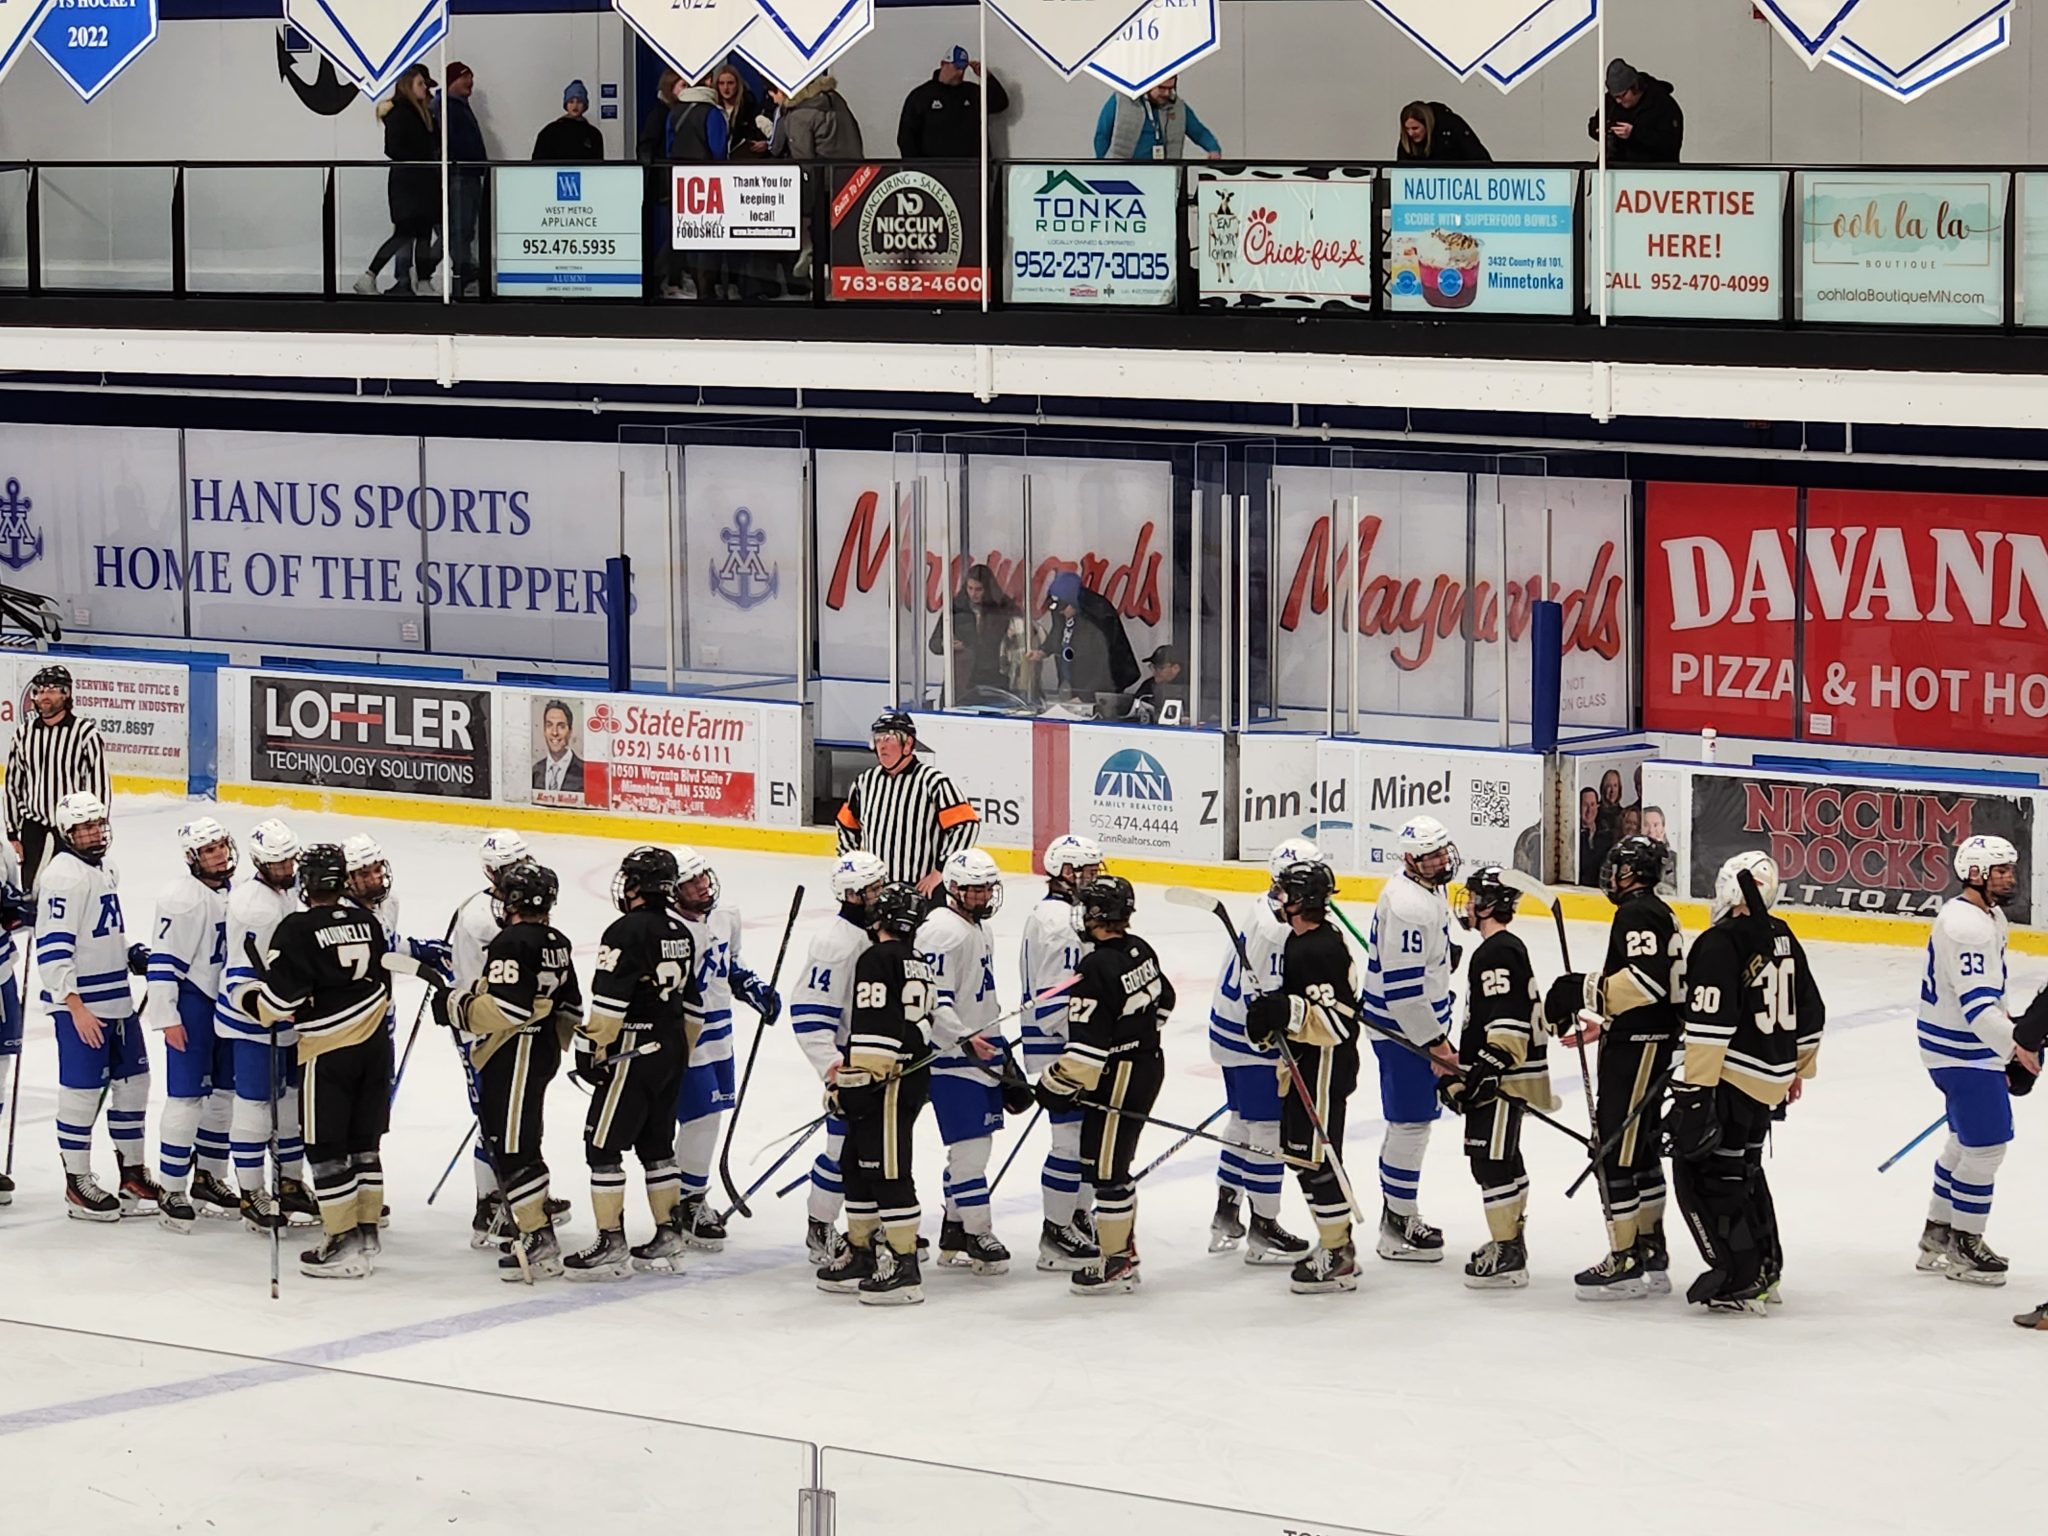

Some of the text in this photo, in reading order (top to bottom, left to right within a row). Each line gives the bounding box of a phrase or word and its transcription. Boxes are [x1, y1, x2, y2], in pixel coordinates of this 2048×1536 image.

[67, 26, 108, 47] 2022
[1115, 17, 1160, 41] 016
[733, 176, 793, 188] Thank You for
[1404, 178, 1546, 201] NAUTICAL BOWLS
[676, 177, 725, 215] ICA
[740, 193, 786, 206] keeping it
[1615, 190, 1755, 215] ADVERTISE
[545, 207, 593, 215] WEST METRO
[750, 210, 776, 222] local!
[861, 174, 959, 256] MANUFACTURING SALES SERVICE
[1033, 198, 1147, 219] TONKA
[1404, 213, 1435, 226] SCORE
[1464, 214, 1520, 227] SUPERFOOD
[1524, 214, 1558, 227] BOWLS
[1833, 200, 1970, 240] ooh la la
[541, 217, 598, 227] APPLIANCE
[876, 216, 943, 234] NICCUM
[1036, 219, 1146, 233] ROOFING
[523, 239, 616, 255] 952.476.5935
[883, 233, 938, 250] DOCKS
[1244, 221, 1365, 270] Chick-fil-A
[1648, 233, 1721, 258] HERE!
[1015, 251, 1170, 280] 952-237-3035
[1488, 256, 1506, 267] 3432
[1509, 257, 1535, 270] County
[1537, 257, 1547, 268] Rd
[1865, 260, 1937, 269] BOUTIQUE
[839, 276, 982, 292] 763-682-4600
[1488, 272, 1564, 290] Minnetonka
[1605, 272, 1769, 292] CALL 952-470-4099
[1817, 289, 1985, 304] oohlalaBoutiqueMN.com
[190, 479, 531, 535] HANUS SPORTS
[93, 545, 637, 616] HOME OF THE SKIPPER
[75, 680, 114, 692] SERVING
[117, 682, 136, 693] THE
[138, 684, 171, 695] OFFICE
[1672, 653, 1811, 703] PIZZA
[1822, 662, 1857, 706] &
[1871, 664, 1970, 712] HOT
[75, 696, 186, 713] HOSPITALITY INDUSTRY
[1576, 693, 1606, 709] GLASS
[82, 718, 155, 736] 2.937.8697
[266, 688, 475, 750] LOFFLER
[625, 706, 744, 742] State Farm
[102, 742, 181, 757] ERRYCOFFEE.COM
[612, 739, 731, 764] (952) 546-6111
[267, 751, 475, 784] TECHNOLOGY SOLUTIONS
[612, 763, 639, 779] 10501
[642, 767, 679, 783] Wayzata
[681, 771, 700, 784] Blvd
[726, 773, 732, 785] 7
[675, 784, 690, 798] MN
[692, 786, 722, 801] 55305
[1100, 771, 1167, 800] ZINN
[1371, 771, 1451, 811] Mine!
[1093, 800, 1174, 812] FAMILY REALTORS
[1743, 783, 1977, 847] NICCUM
[1089, 813, 1179, 834] 952.474.4444
[1098, 833, 1171, 848] ZinnRealtors.com
[1769, 831, 1949, 893] DOCKS
[48, 897, 66, 920] 15
[1837, 887, 1887, 909] TO
[160, 917, 172, 939] 7
[1401, 930, 1423, 953] 19
[1626, 931, 1657, 957] 23
[337, 944, 371, 981] 7
[1064, 946, 1081, 971] 11
[1960, 952, 1985, 976] 33
[488, 959, 520, 984] 26
[808, 966, 832, 992] 14
[1481, 968, 1511, 997] 25
[856, 982, 888, 1009] 28
[1691, 985, 1721, 1014] 30
[1750, 957, 1797, 1035] 30
[1069, 997, 1098, 1023] 27
